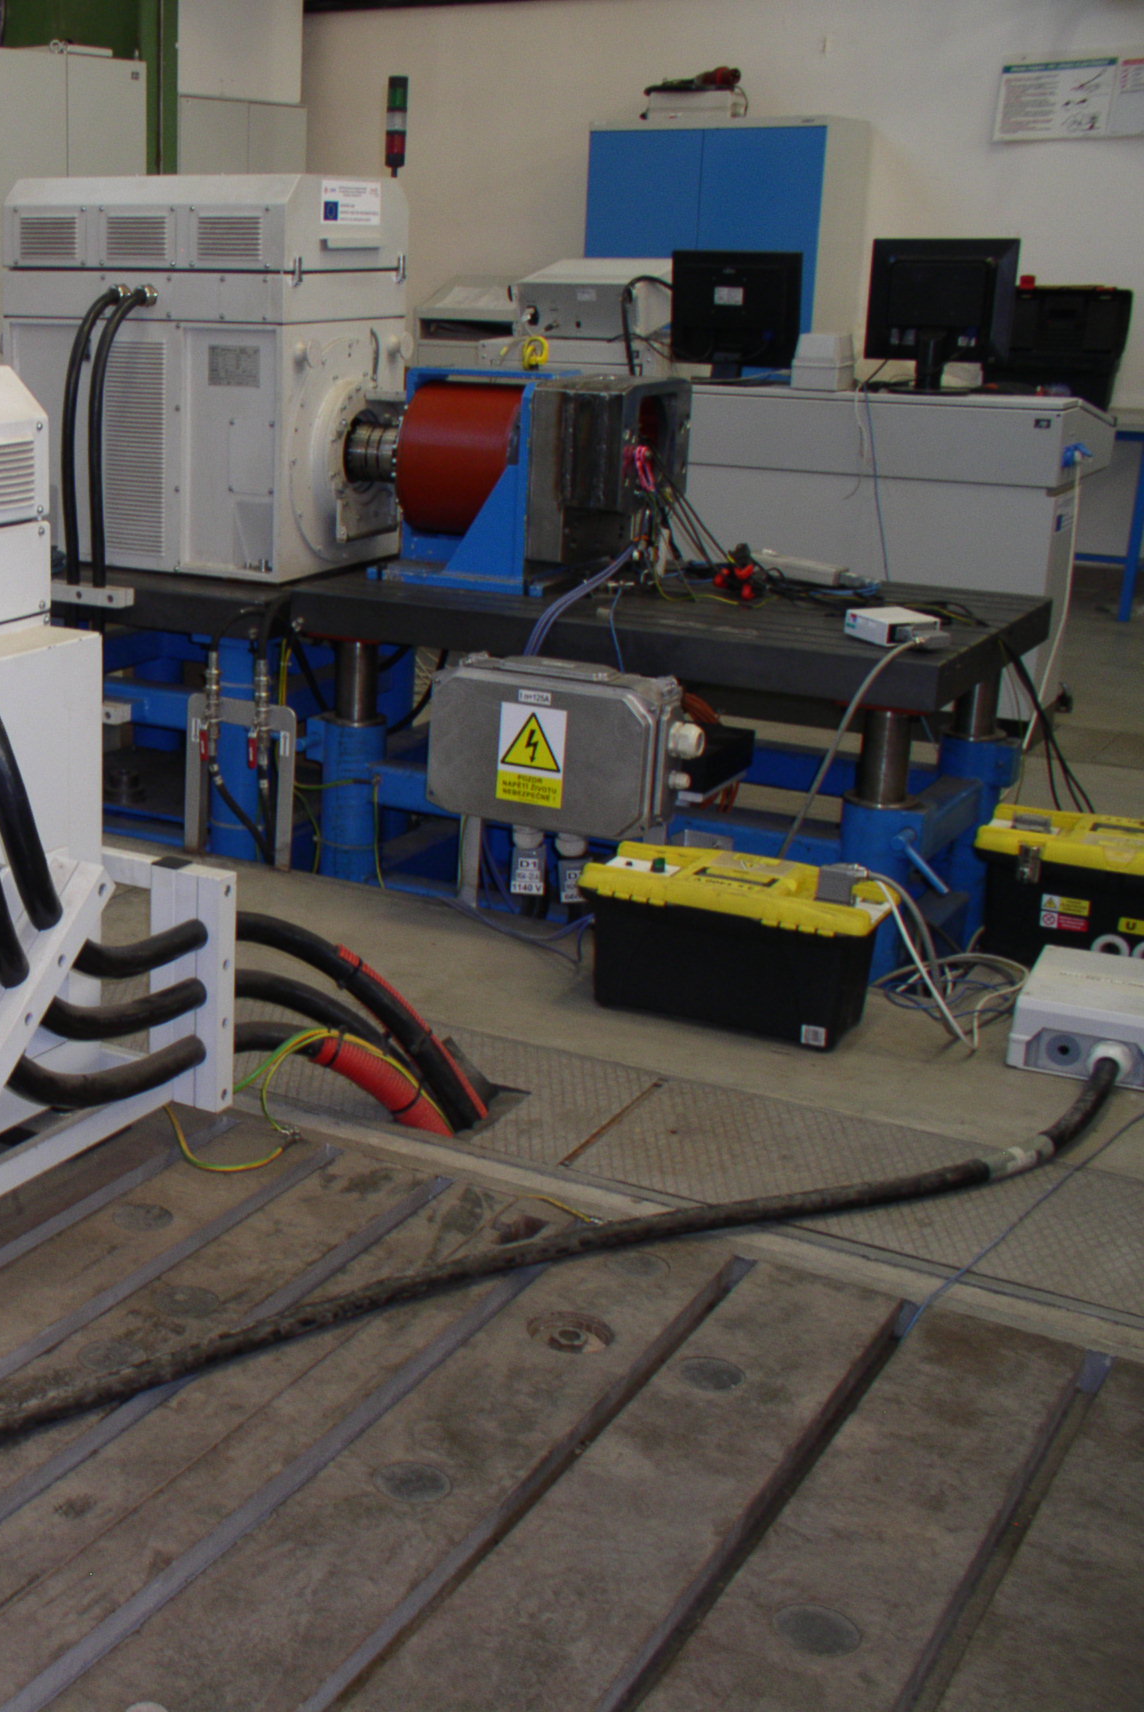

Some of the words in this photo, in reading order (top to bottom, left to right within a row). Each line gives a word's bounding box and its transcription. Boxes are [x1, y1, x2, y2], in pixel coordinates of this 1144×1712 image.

[517, 774, 543, 783] POZOR
[520, 860, 537, 868] D1
[513, 883, 533, 892] 1140
